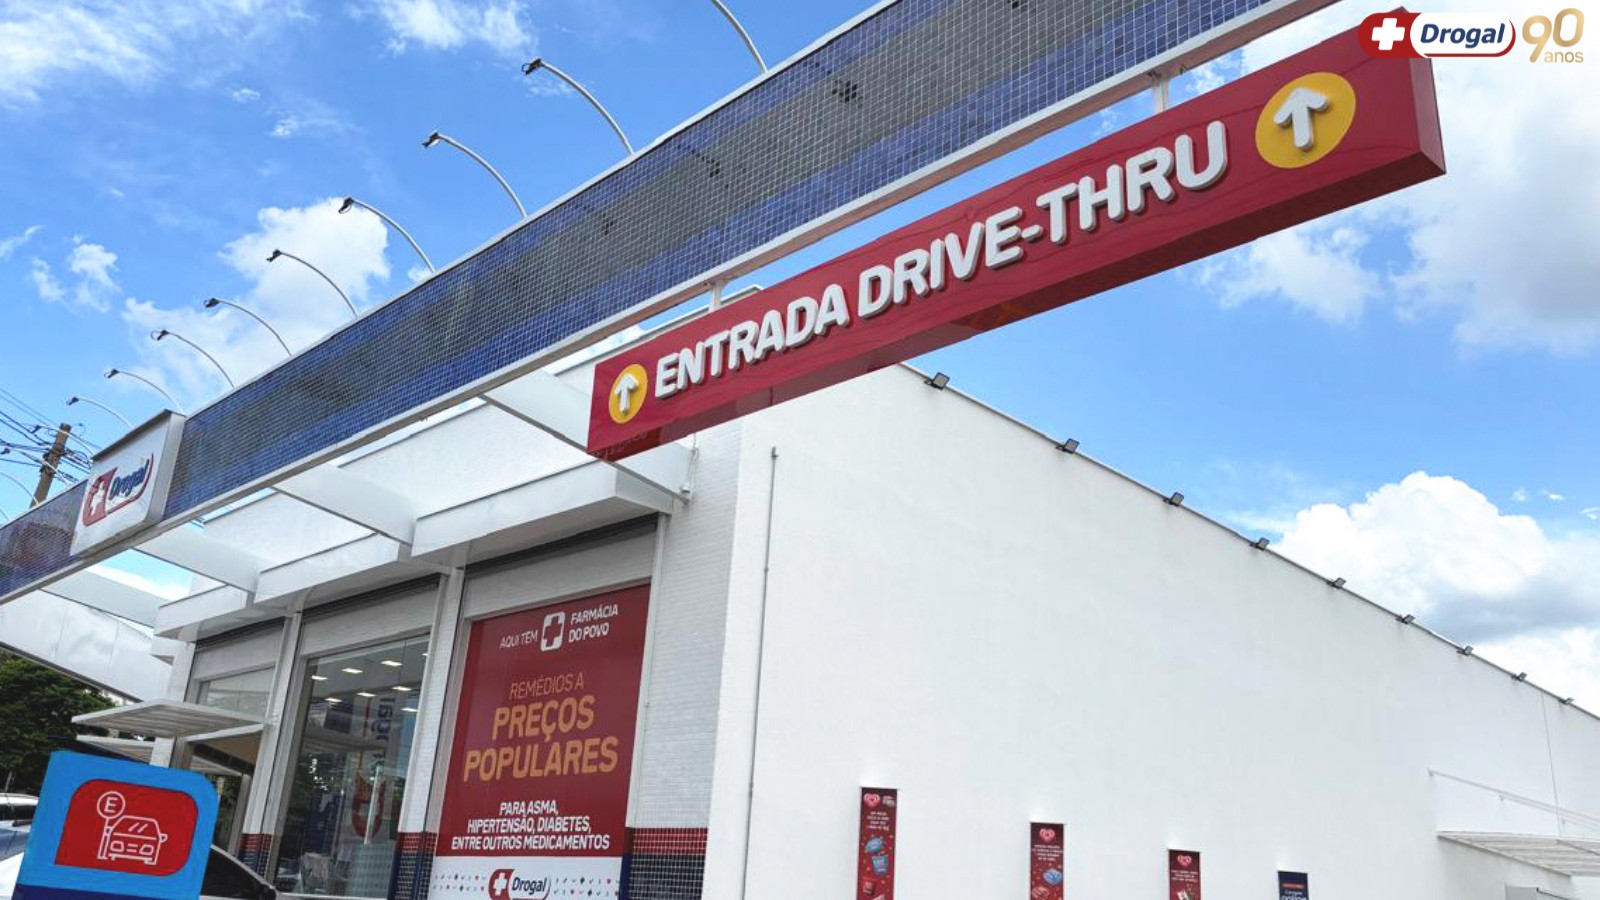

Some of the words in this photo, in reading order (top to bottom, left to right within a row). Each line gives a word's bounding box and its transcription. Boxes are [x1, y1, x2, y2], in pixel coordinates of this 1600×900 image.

[655, 284, 849, 399] ENTRADA
[858, 120, 1228, 318] DRIVE-THRU
[108, 459, 150, 500] Drogal
[571, 604, 619, 626] FARMÁCIA
[500, 633, 520, 649] AQUI
[521, 630, 538, 645] TEM
[568, 628, 582, 643] DO
[582, 622, 610, 641] POVO
[510, 674, 573, 700] REMÉDIOS
[575, 672, 584, 690] A
[492, 695, 596, 742] PREÇOS
[464, 736, 619, 782] POPULARES
[104, 796, 118, 813] E
[499, 801, 526, 816] PARA
[526, 800, 559, 815] ASMA,
[467, 814, 535, 835] HIPERTENSÃO,
[537, 816, 592, 834] DIABETES,
[451, 836, 483, 850] ENTRE
[484, 836, 522, 850] OUTROS
[523, 834, 610, 850] MEDICAMENTOS
[511, 877, 547, 894] Drogal
